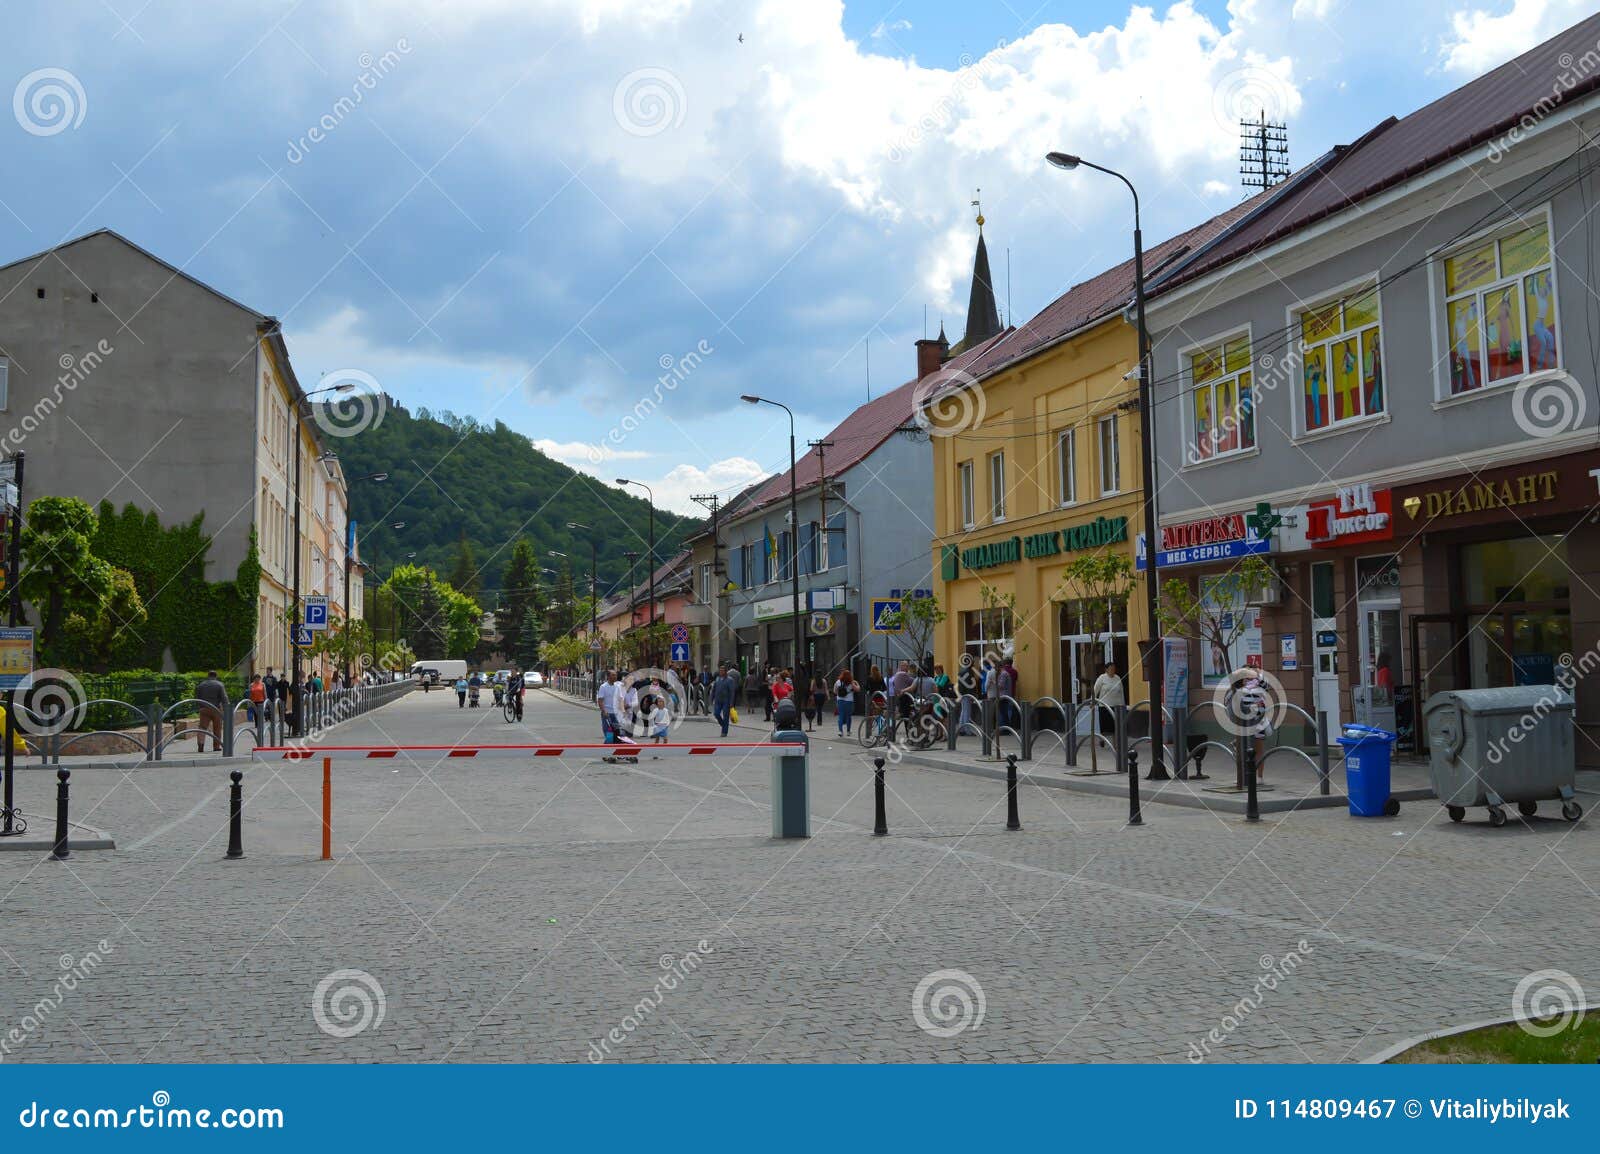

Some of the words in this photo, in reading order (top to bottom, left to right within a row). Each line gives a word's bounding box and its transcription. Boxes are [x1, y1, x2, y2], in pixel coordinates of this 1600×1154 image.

[963, 536, 1021, 569] ОЩАДНИЙ
[1024, 531, 1061, 559] БАНК
[1062, 516, 1128, 552] УКРАЇНИ
[1162, 513, 1246, 550] АПТЕКА
